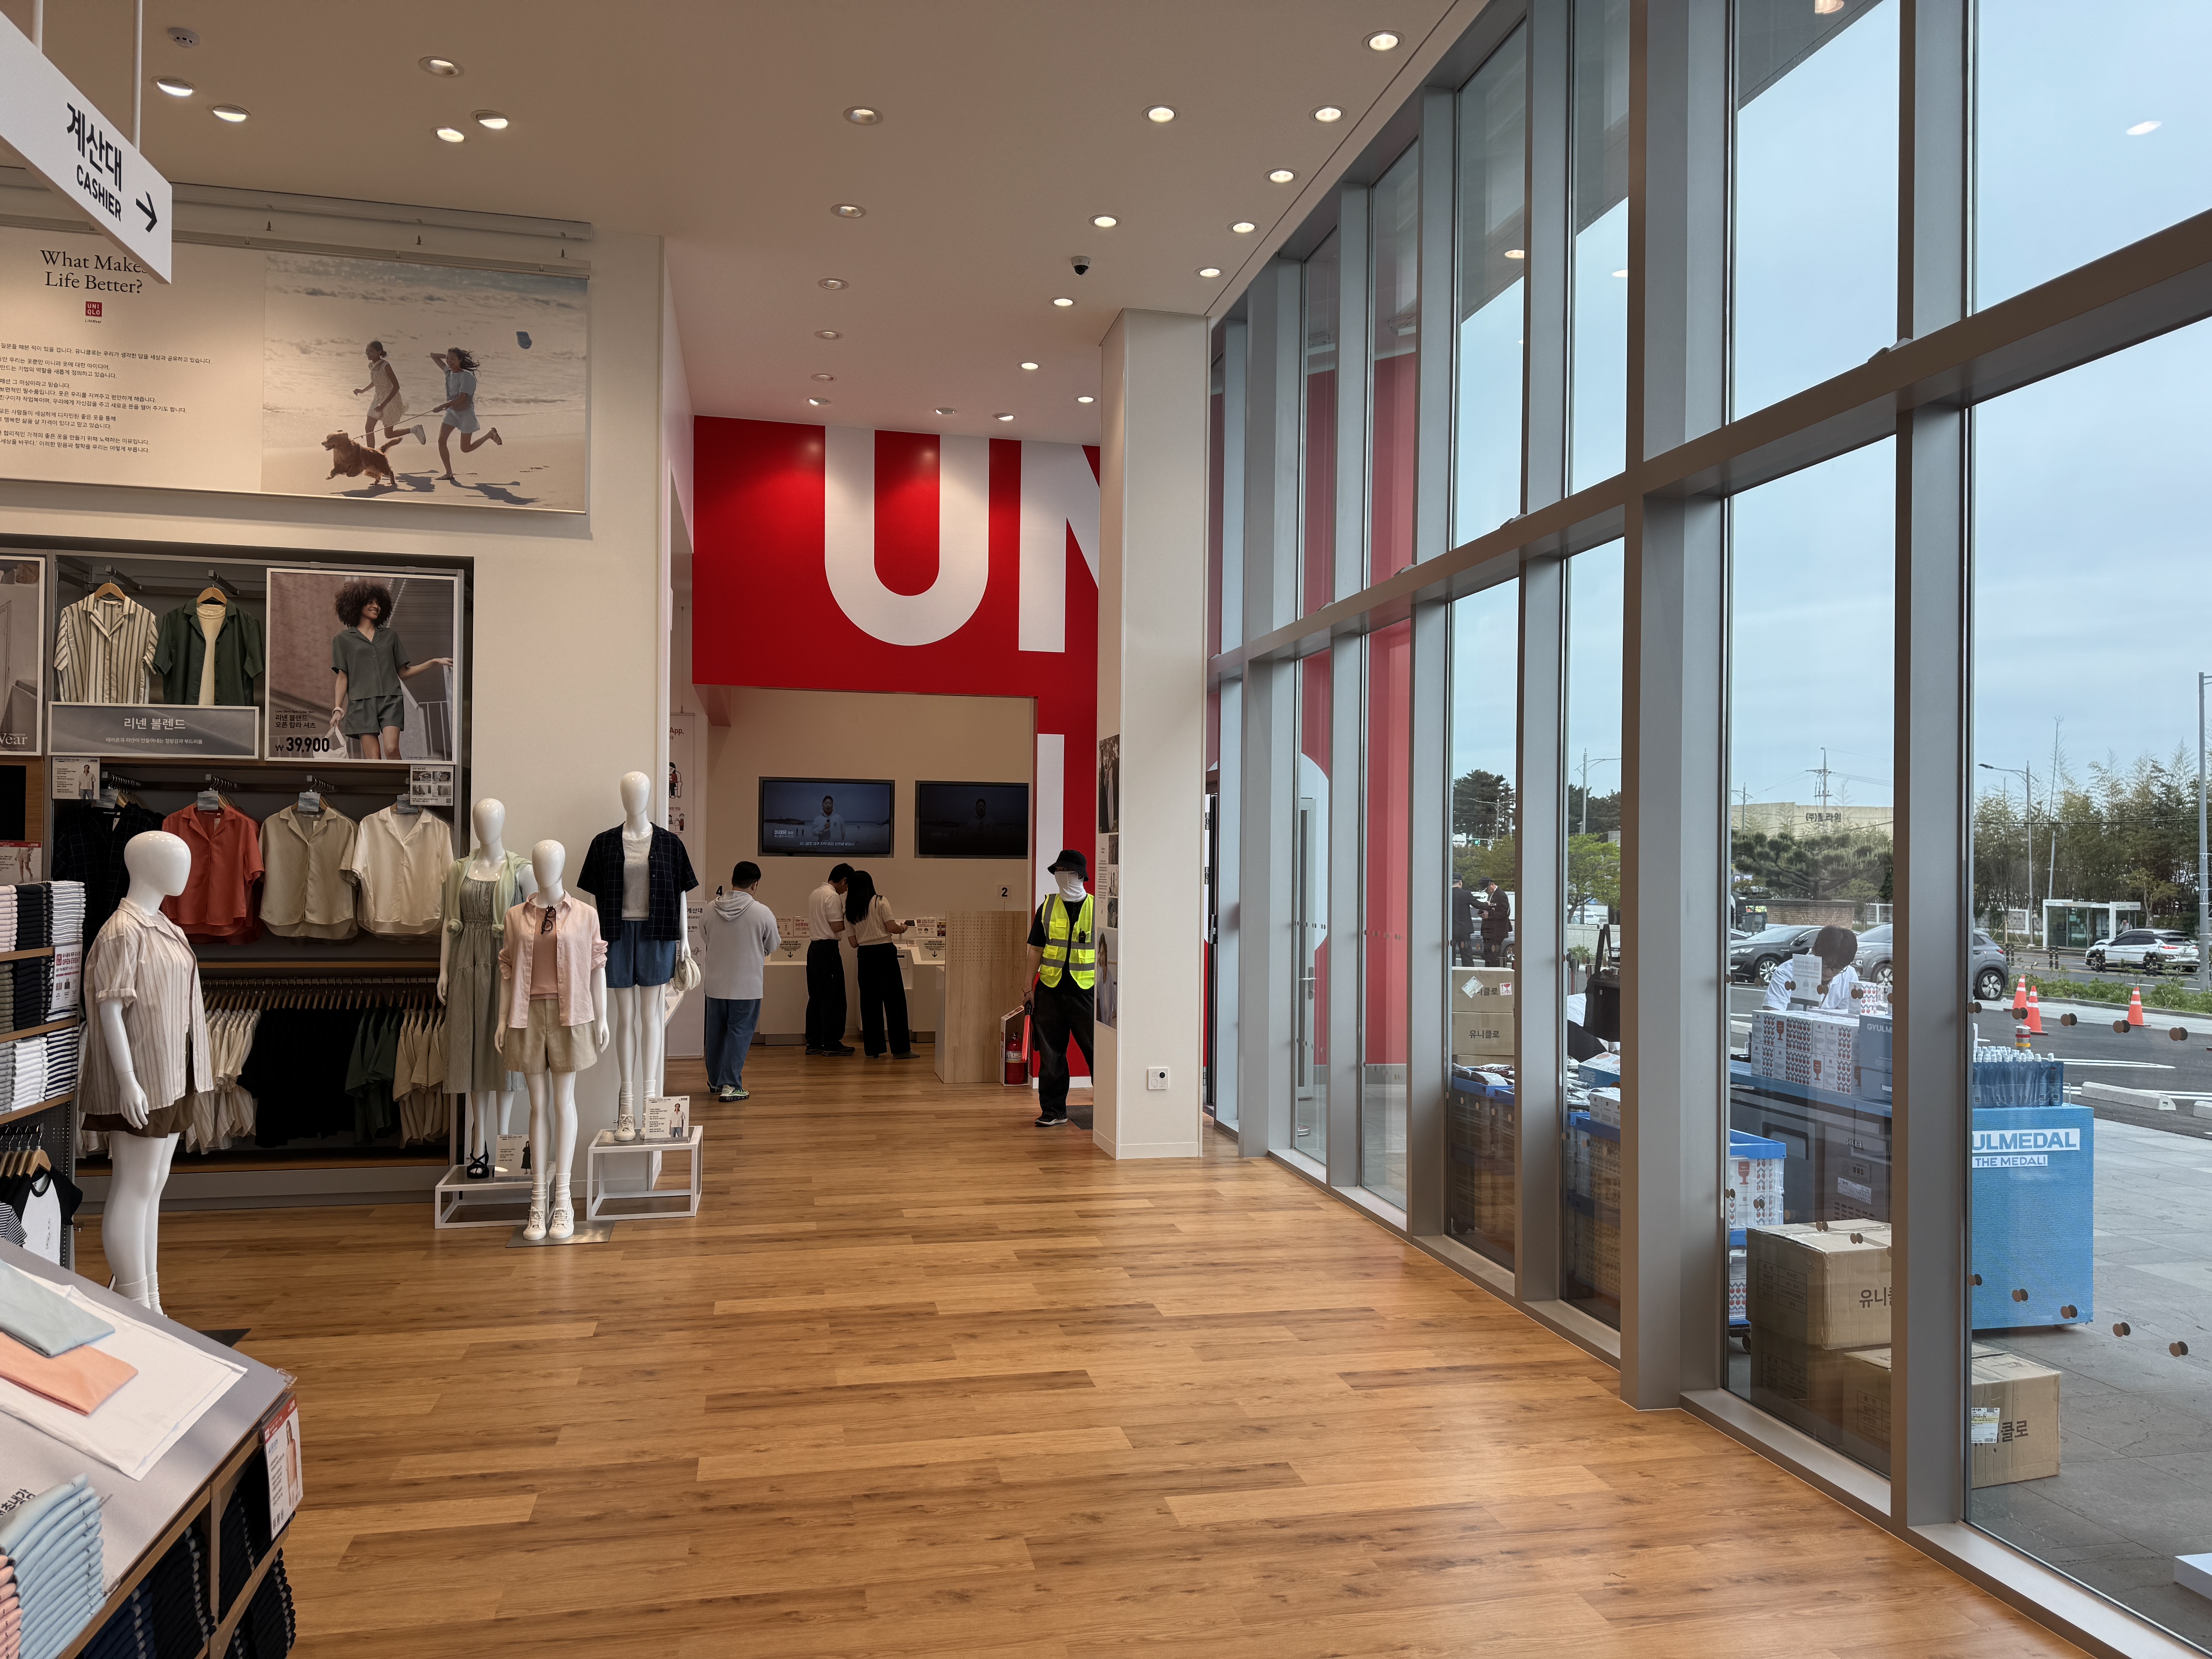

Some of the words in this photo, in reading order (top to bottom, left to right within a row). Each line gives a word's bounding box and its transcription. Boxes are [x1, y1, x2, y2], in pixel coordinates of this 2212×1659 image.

[67, 102, 122, 192] 계산대
[76, 165, 121, 222] CASHIER
[41, 251, 89, 268] What
[45, 271, 80, 289] Life
[85, 276, 143, 294] Better?
[124, 718, 147, 729] 리넨
[151, 718, 186, 730] 블렌드
[716, 885, 723, 896] 4
[1001, 887, 1008, 897] 2
[1469, 1030, 1500, 1039] 유니클로
[1975, 1158, 1997, 1166] THE
[2000, 1156, 2046, 1166] MEDAL!
